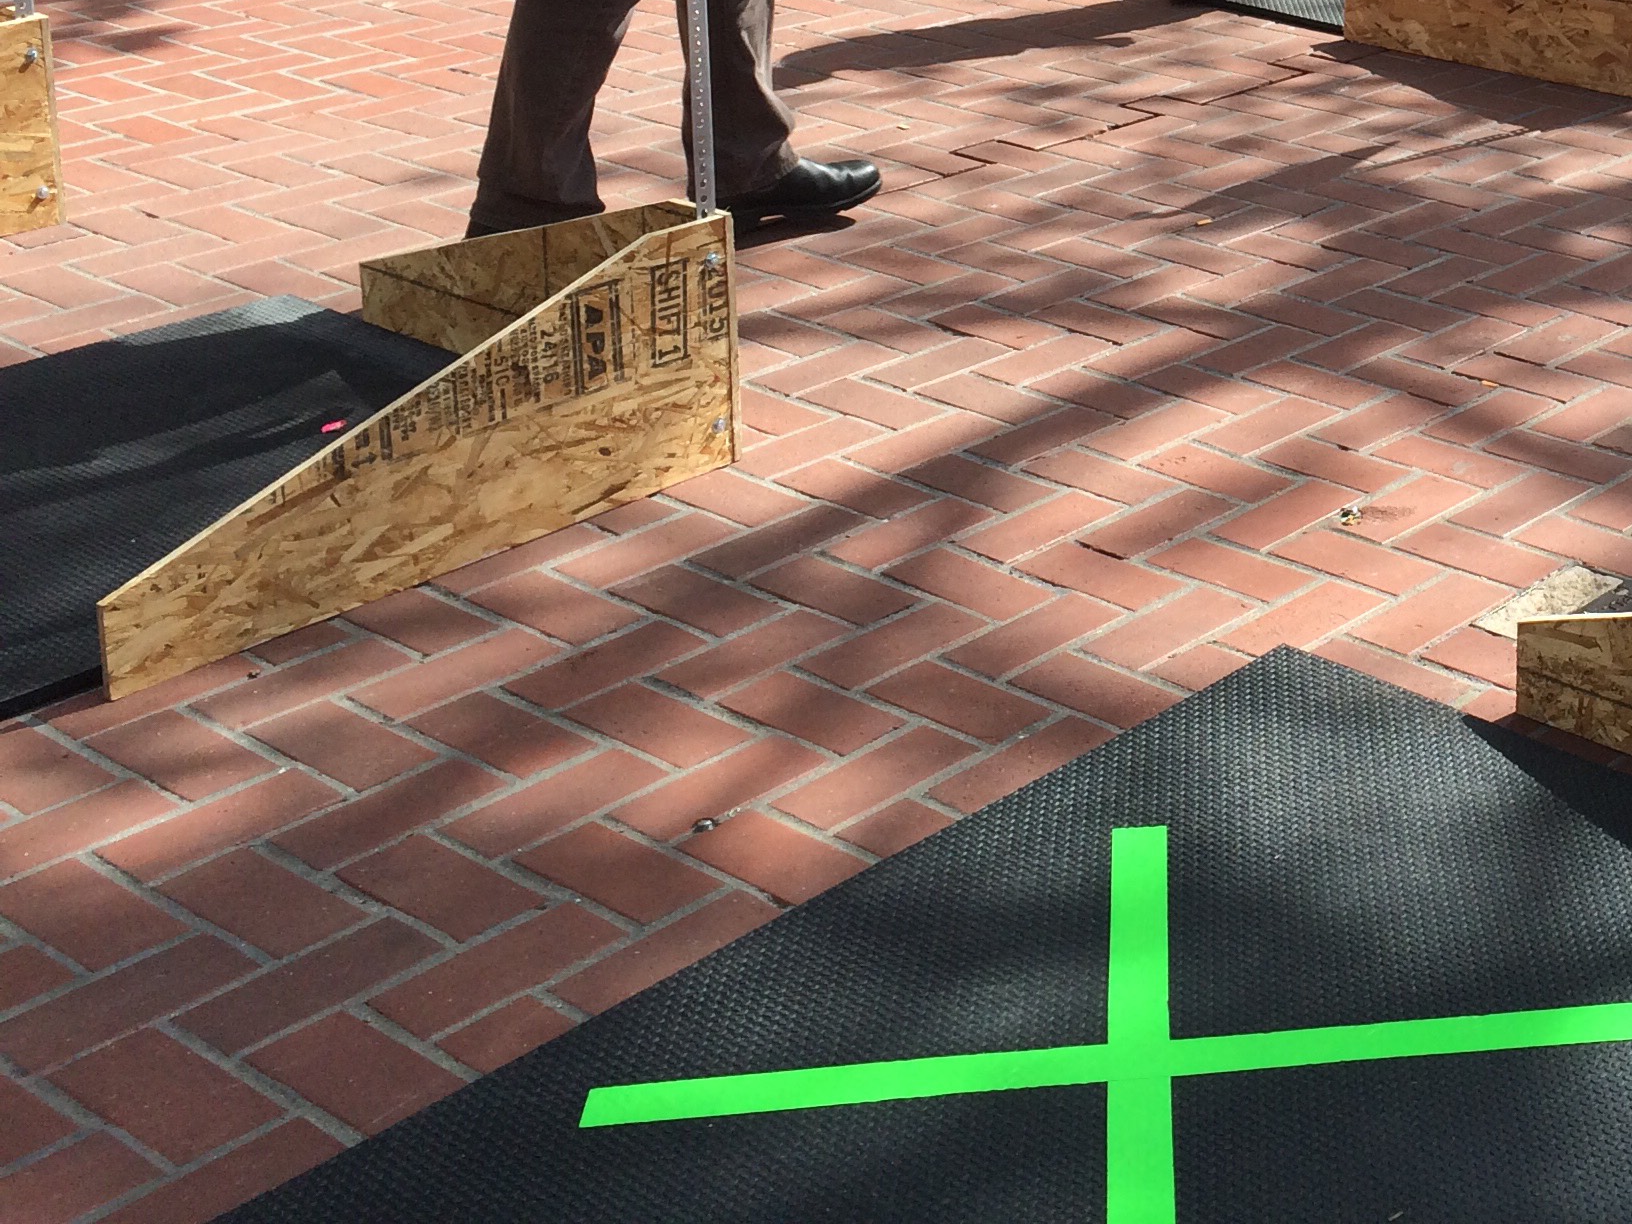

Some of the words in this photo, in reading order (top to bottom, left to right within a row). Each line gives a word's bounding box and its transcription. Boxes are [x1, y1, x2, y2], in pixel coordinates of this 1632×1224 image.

[657, 270, 682, 336] SHIFT
[584, 303, 607, 381] APA
[658, 344, 682, 360] 1
